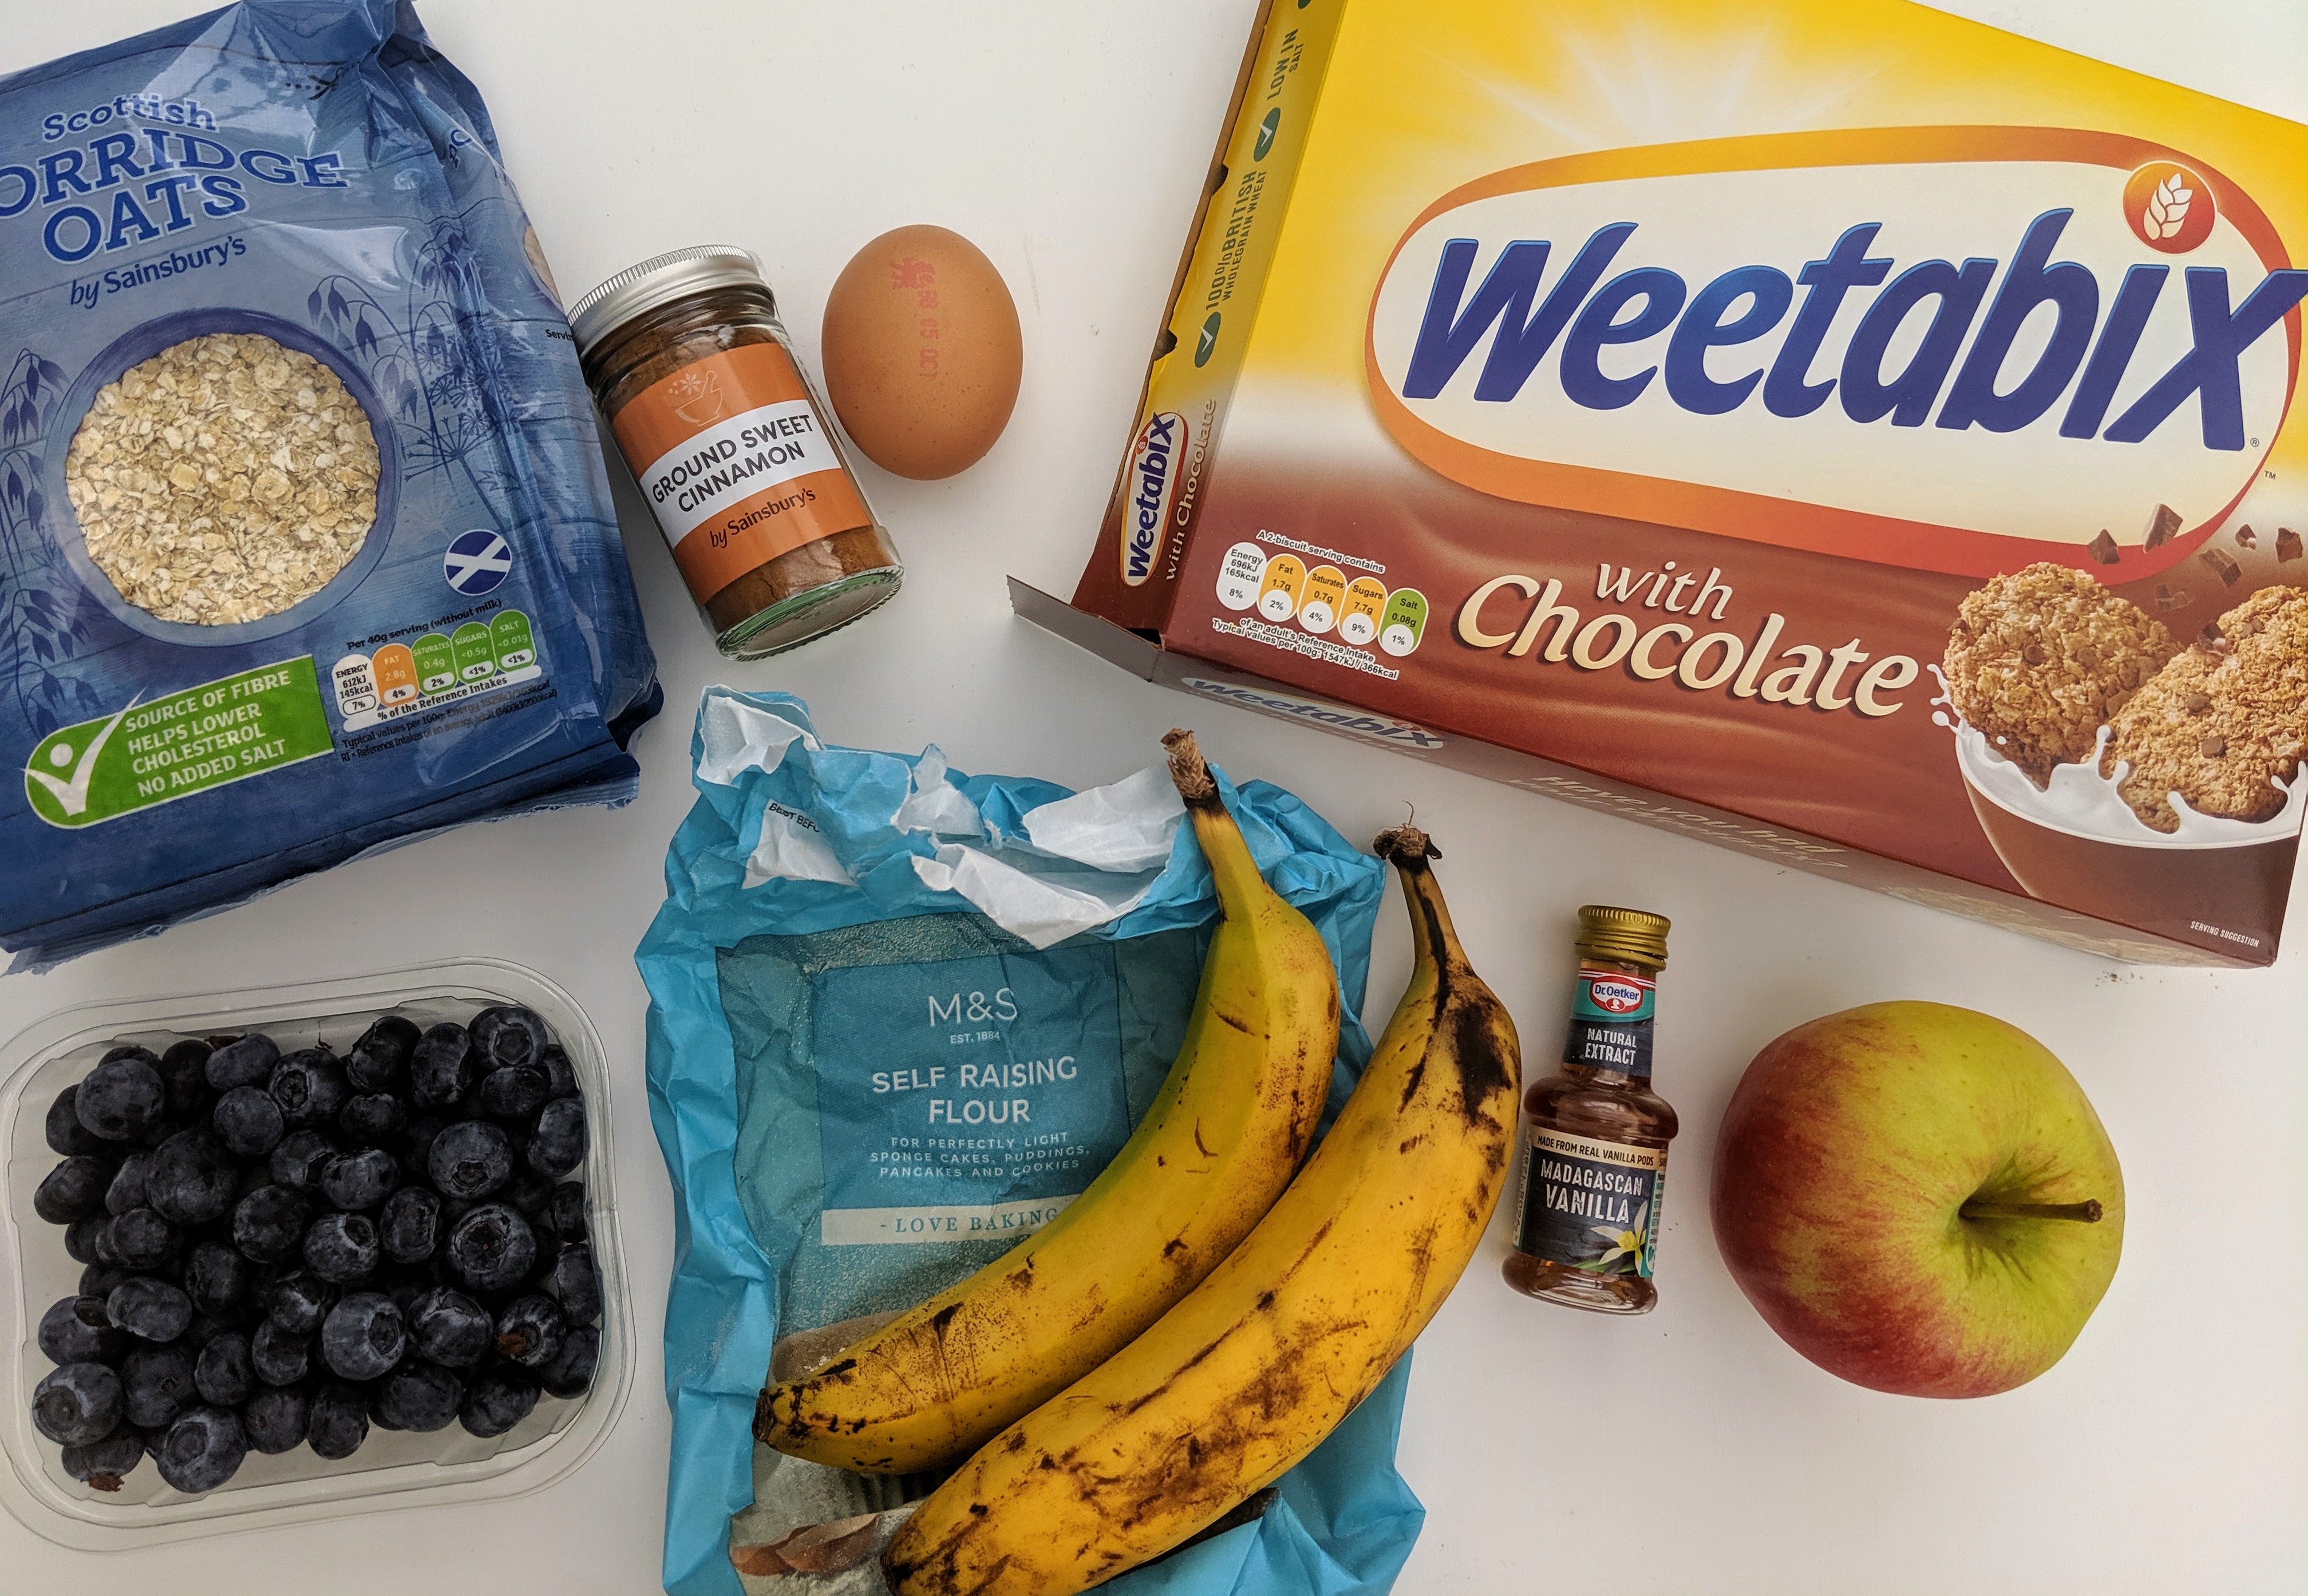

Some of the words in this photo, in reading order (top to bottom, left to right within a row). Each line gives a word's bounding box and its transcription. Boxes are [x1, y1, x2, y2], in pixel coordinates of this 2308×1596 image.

[1267, 58, 1290, 100] LOW
[1281, 29, 1298, 54] IN
[1289, 44, 1304, 72] SALT
[43, 94, 216, 141] Scottish
[0, 127, 348, 218] ORRIDGE
[43, 175, 249, 263] OATS
[1222, 171, 1256, 252] BRITISH
[1222, 215, 1254, 301] WHOLEGRAIN
[1247, 171, 1267, 212] WHEAT
[70, 280, 100, 308] by
[104, 236, 246, 294] Sainsbury's
[1402, 207, 2308, 451] Weetabix
[653, 439, 737, 504] GROUND
[741, 414, 813, 449] SWEET
[678, 441, 805, 512] CINNAMON
[1128, 412, 1175, 577] Weetabix
[1166, 532, 1185, 580] with
[1176, 399, 1215, 527] Chocolate
[710, 528, 728, 549] by
[728, 488, 816, 536] Sainsbury's
[1231, 548, 1263, 565] Energy
[1258, 531, 1265, 539] A
[1267, 534, 1307, 548] 2-biscuit
[1309, 546, 1342, 563] serving
[1345, 556, 1384, 572] contains
[1225, 567, 1259, 583] 165kcal
[1231, 559, 1258, 572] 696kJ
[1278, 564, 1293, 574] Fat
[1272, 579, 1291, 591] 1.7g
[1312, 573, 1343, 588] Saturates
[1596, 561, 1732, 619] with
[1229, 588, 1243, 599] 8%
[1314, 591, 1333, 604] 0.7g
[1353, 584, 1383, 600] Sugars
[1269, 601, 1283, 611] 2%
[1354, 602, 1373, 615] 7.7g
[1400, 598, 1418, 610] Salt
[347, 640, 365, 650] Per
[367, 634, 387, 643] 40g
[389, 623, 429, 638] serving
[430, 609, 475, 629] (without
[476, 598, 502, 614] milk)
[500, 621, 519, 633] SALT
[1309, 611, 1323, 622] 4%
[1392, 613, 1417, 628] 0.08g
[455, 630, 487, 646] SUGARS
[1351, 623, 1365, 634] 9%
[413, 642, 450, 656] SATURATES
[498, 634, 528, 647] <0.01g
[1214, 619, 1244, 635] Typical
[1247, 629, 1276, 644] values
[1278, 640, 1294, 649] per
[1297, 644, 1320, 657] 100g:
[1323, 652, 1354, 667] 1547kJ
[1362, 663, 1397, 679] 366kcal
[1266, 626, 1295, 639] adult's
[1298, 634, 1343, 653] Reference
[1346, 647, 1374, 662] Intake
[1392, 635, 1405, 645] 1%
[1457, 575, 1919, 717] Chocolate
[384, 655, 400, 665] FAT
[461, 647, 487, 658] <0.5g
[508, 654, 525, 663] <1%
[335, 663, 367, 678] ENERGY
[424, 658, 445, 669] 0.4g
[469, 666, 486, 675] <1%
[343, 675, 366, 689] 612kJ
[385, 670, 406, 682] 2.8g
[431, 678, 444, 688] 2%
[125, 697, 197, 732] SOURCE
[203, 689, 227, 708] OF
[231, 670, 291, 700] FIBRE
[340, 682, 373, 699] 145kcal
[377, 712, 388, 720] %
[390, 706, 399, 717] of
[401, 704, 418, 714] the
[419, 688, 468, 709] Reference
[469, 677, 508, 693] Intakes
[392, 689, 406, 698] 4%
[352, 701, 366, 710] 7%
[1193, 680, 1446, 747] Weetabix
[128, 723, 188, 754] HELPS
[192, 703, 262, 734] LOWER
[342, 732, 376, 749] Typical
[376, 724, 405, 738] values
[406, 720, 421, 731] per
[133, 724, 266, 774] CHOLESTEROL
[357, 741, 394, 758] Reference
[394, 732, 423, 745] Intakes
[137, 775, 165, 797] NO
[172, 755, 236, 788] ADDED
[241, 739, 286, 765] SALT
[769, 803, 796, 820] BEST
[1532, 777, 1648, 805] Have
[1640, 807, 1742, 828] you
[1738, 830, 1848, 852] had
[2190, 921, 2219, 936] SERVING
[2220, 929, 2259, 947] SUGGESTION
[928, 987, 1018, 1026] M&S
[950, 1033, 974, 1044] EST.
[976, 1031, 1000, 1041] 1884
[1587, 1028, 1637, 1048] NATURAL
[1585, 1042, 1636, 1065] EXTRACT
[872, 1066, 946, 1093] SELF
[960, 1056, 1077, 1088] RAISING
[928, 1099, 1030, 1124] FLOUR
[891, 1137, 919, 1148] FOR
[928, 1138, 1015, 1149] PERFECTLY
[1025, 1132, 1068, 1147] LIGHT
[1538, 1135, 1554, 1148] MADE
[1555, 1140, 1577, 1153] FROM
[1579, 1145, 1599, 1158] REAL
[1603, 1149, 1635, 1163] VANILLA
[1637, 1155, 1654, 1166] PODS
[870, 1152, 932, 1162] SPONGE
[940, 1153, 995, 1164] CAKES,
[1005, 1145, 1089, 1162] PUDDINGS,
[880, 1167, 962, 1177] PANCAKES
[973, 1167, 1003, 1177] AND
[1012, 1160, 1079, 1176] COOKIES
[1540, 1159, 1642, 1196] MADAGASCAN
[1546, 1183, 1629, 1223] VANILLA
[895, 1217, 958, 1233] LOVE
[969, 1208, 1058, 1231] BAKING
